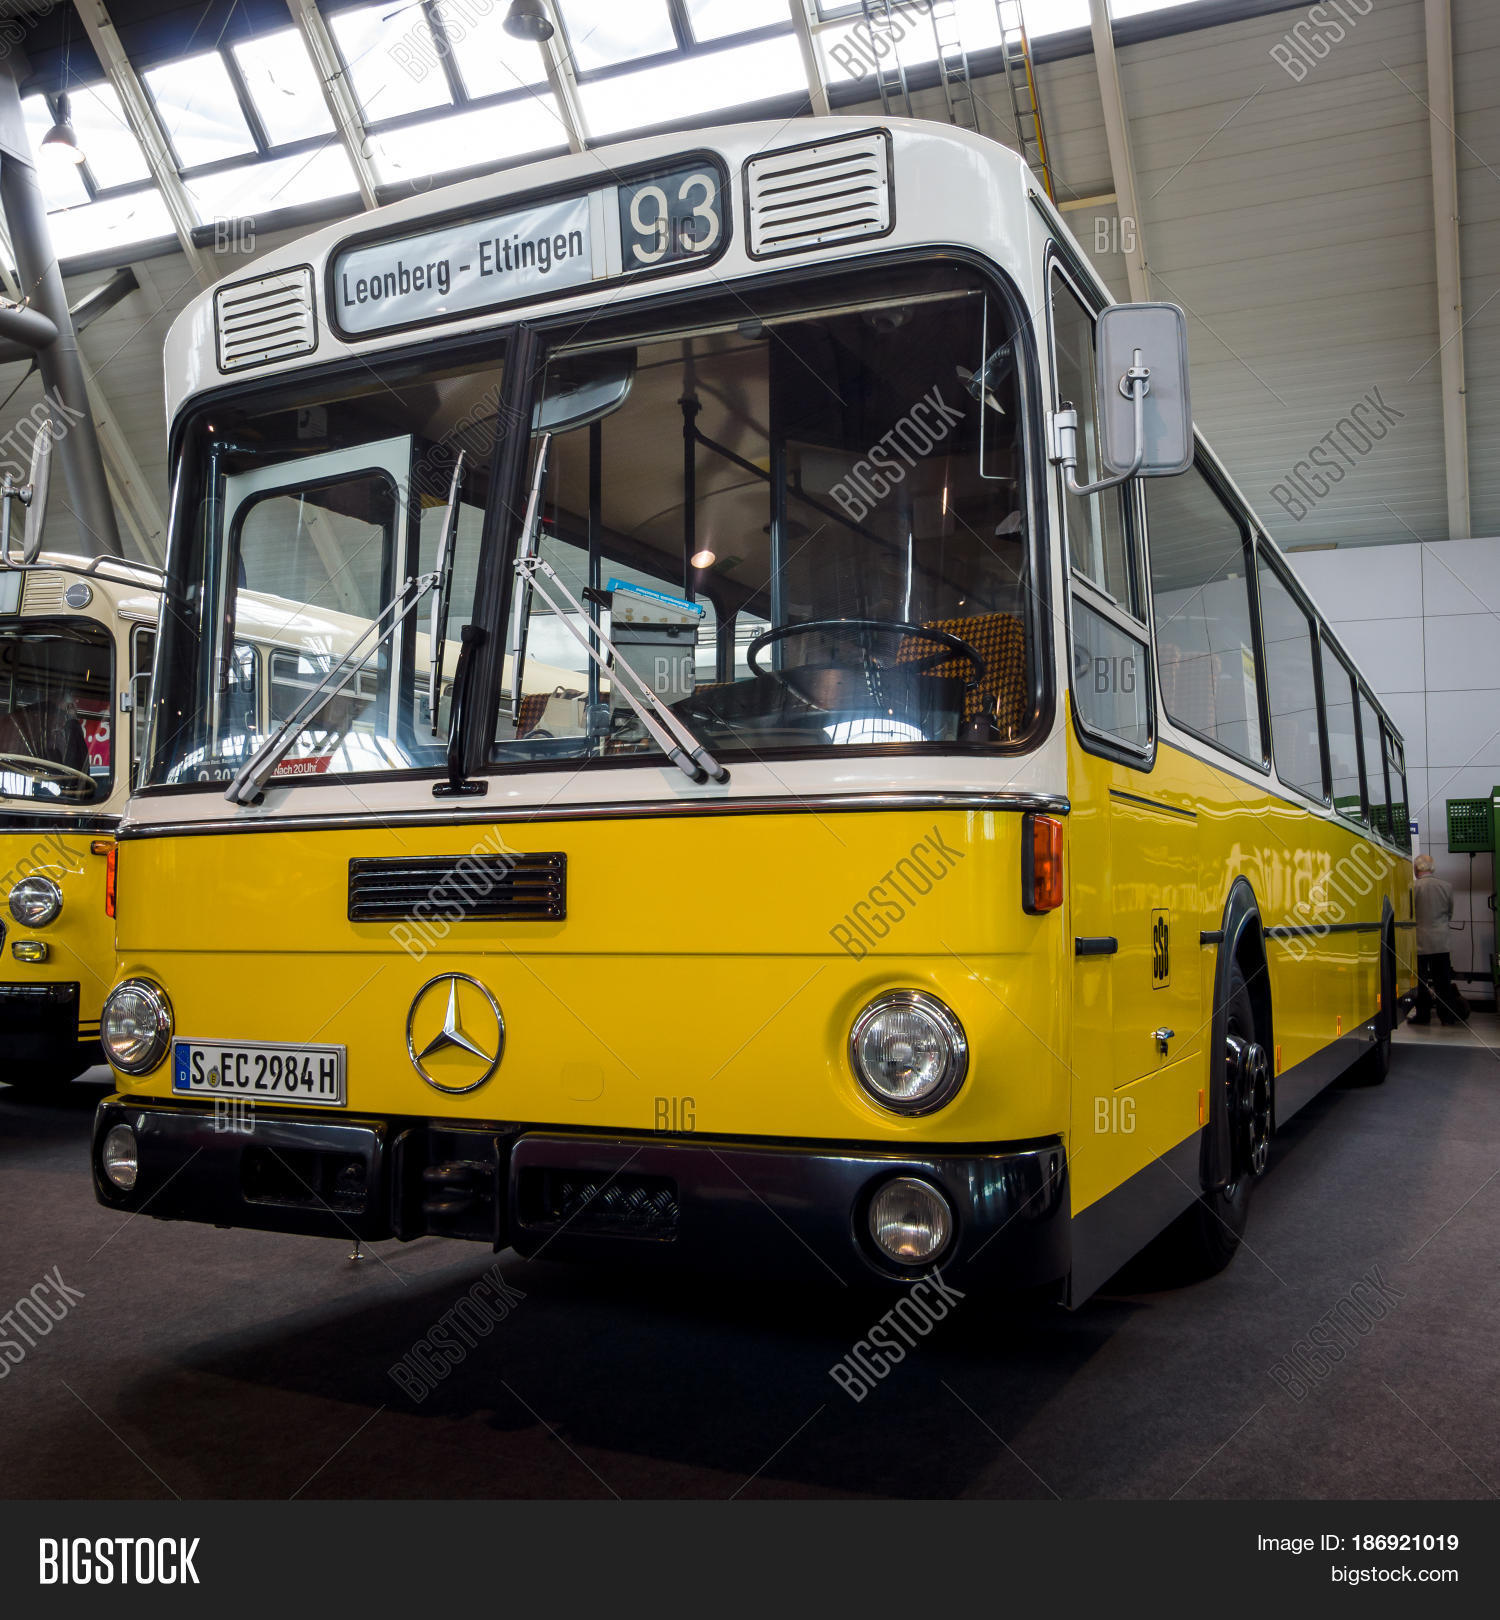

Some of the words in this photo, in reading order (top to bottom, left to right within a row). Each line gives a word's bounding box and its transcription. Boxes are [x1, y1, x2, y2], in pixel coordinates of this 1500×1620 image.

[629, 173, 720, 264] 93
[342, 257, 450, 306] Leonberg
[479, 229, 583, 277] Eltingen
[1153, 916, 1168, 980] SSB
[180, 1071, 187, 1081] D
